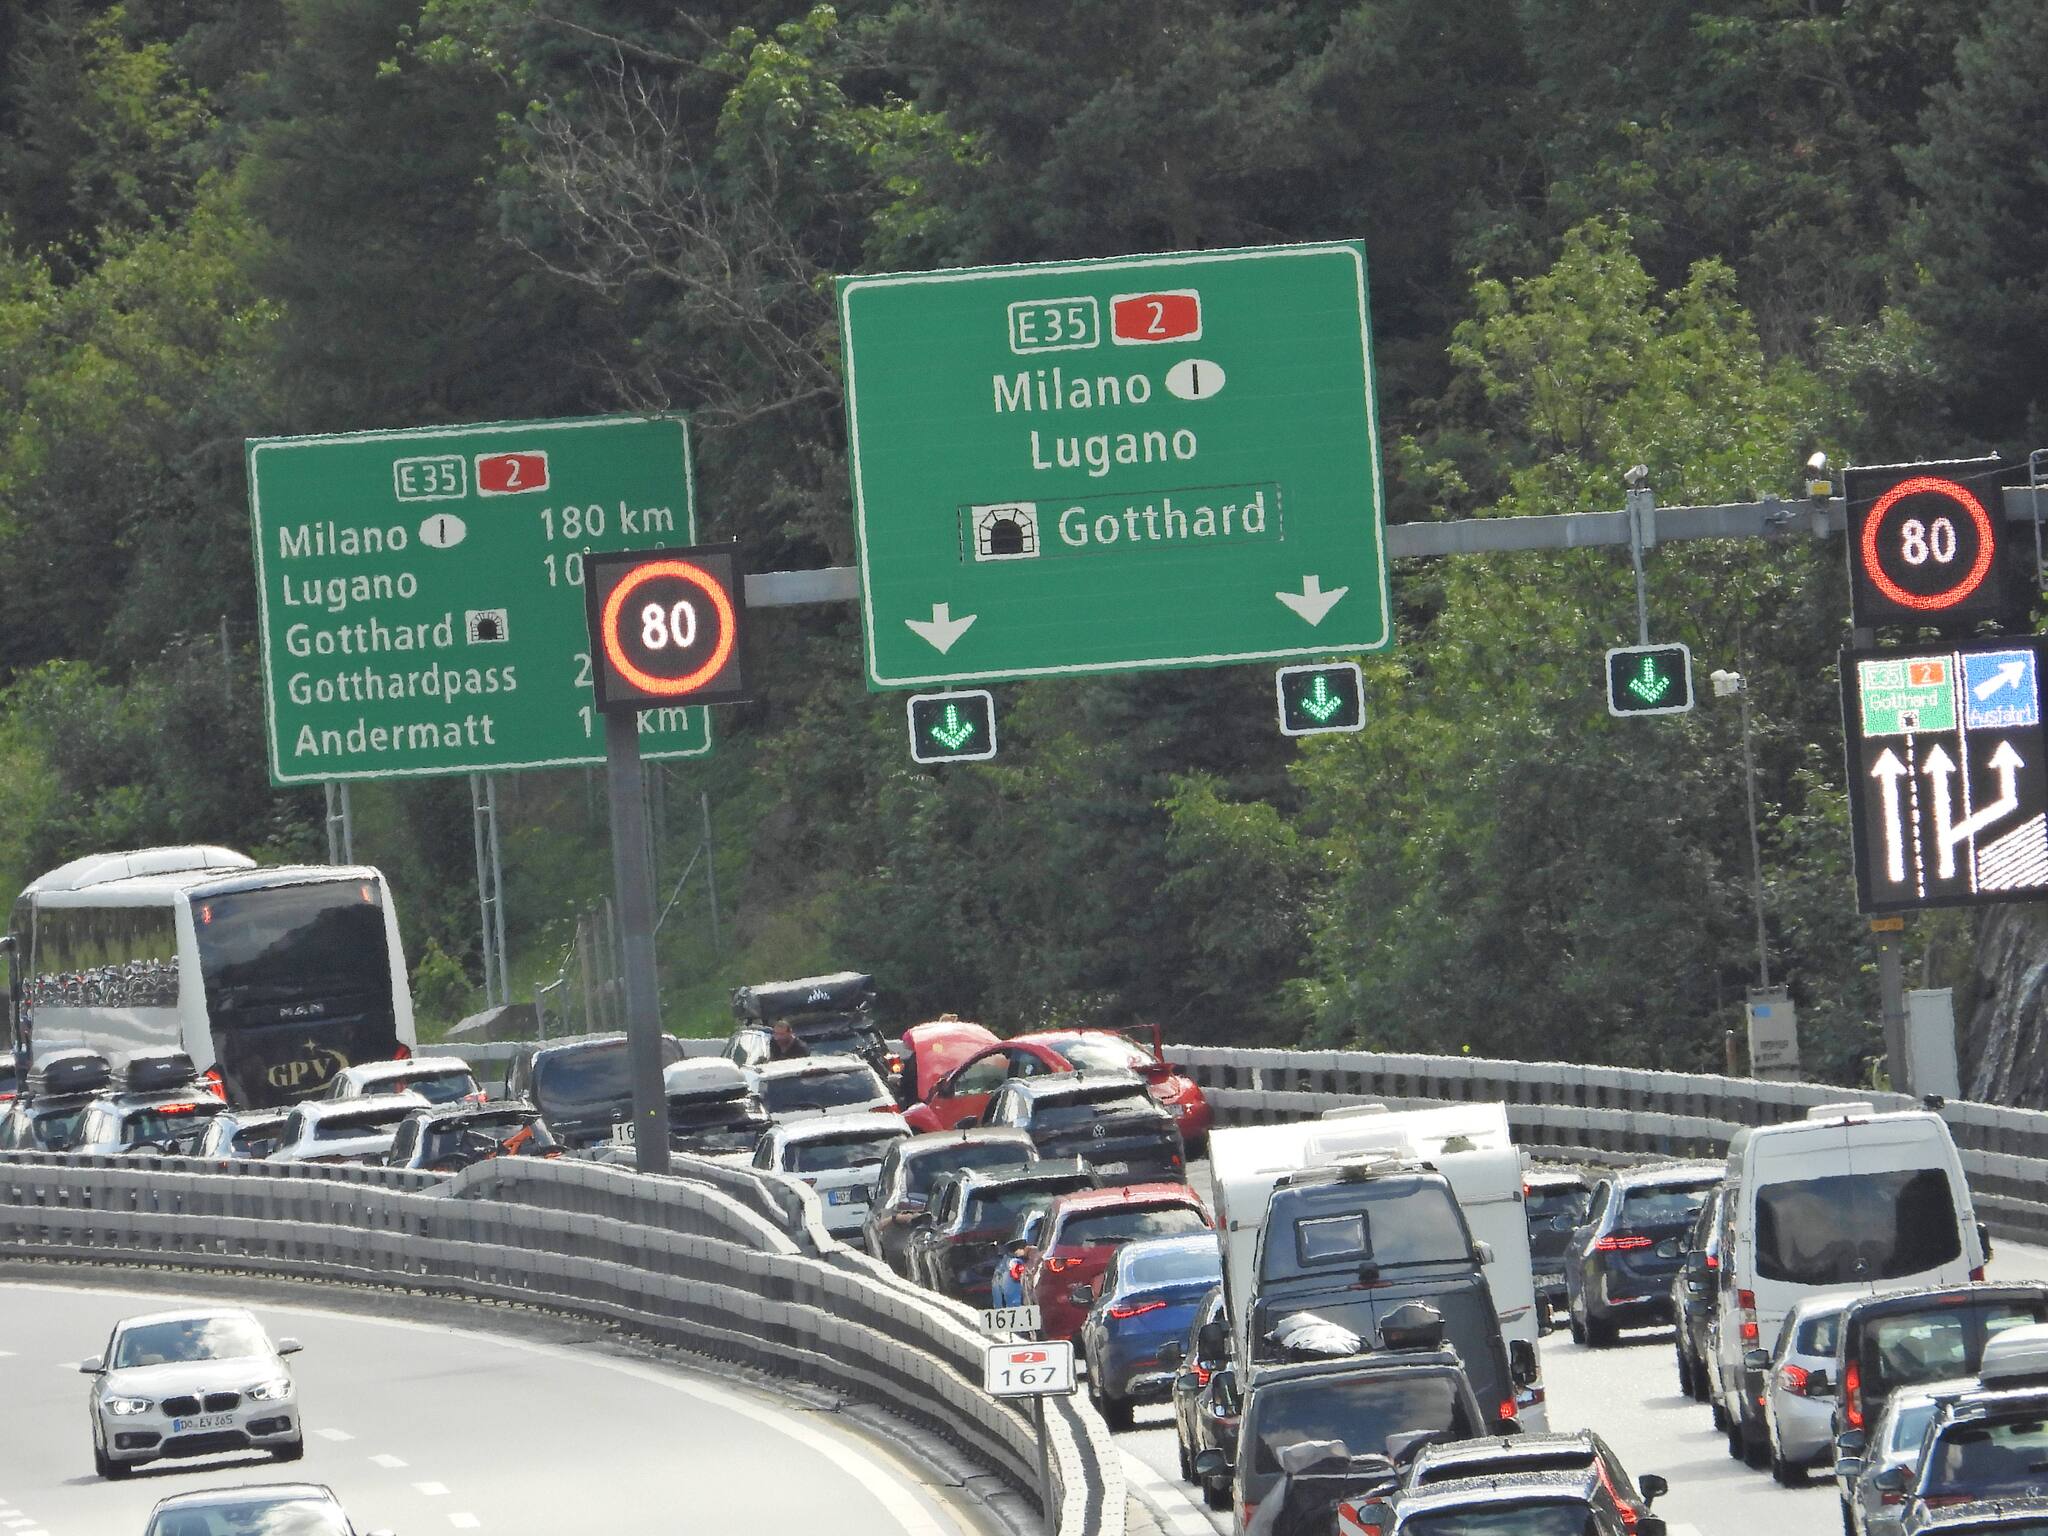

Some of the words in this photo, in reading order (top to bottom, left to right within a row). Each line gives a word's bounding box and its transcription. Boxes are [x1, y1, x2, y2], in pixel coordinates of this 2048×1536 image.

[1019, 307, 1087, 343] E35
[1147, 302, 1165, 334] 2
[993, 367, 1152, 413] Milano
[1031, 428, 1198, 477] Lugano
[400, 466, 456, 494] E35
[506, 459, 522, 487] 2
[279, 521, 408, 559] Milano
[541, 504, 605, 541] 180
[619, 501, 674, 535] km
[1058, 491, 1266, 547] Gotthard
[1900, 517, 1957, 566] 80
[284, 572, 418, 613] Lugano
[543, 552, 584, 587] 10
[286, 614, 455, 657] Gotthard
[641, 601, 697, 650] 80
[288, 662, 518, 706] Gotthardpass
[1868, 666, 1901, 686] E35
[1920, 666, 1930, 684] 2
[1869, 689, 1939, 710] Gotthard
[295, 713, 495, 756] Andermatt
[636, 708, 689, 735] km
[280, 1003, 325, 1017] MAN
[268, 1057, 332, 1088] GPV
[984, 1308, 1033, 1330] 167.1
[1001, 1367, 1057, 1387] 167
[1024, 1353, 1033, 1363] 2
